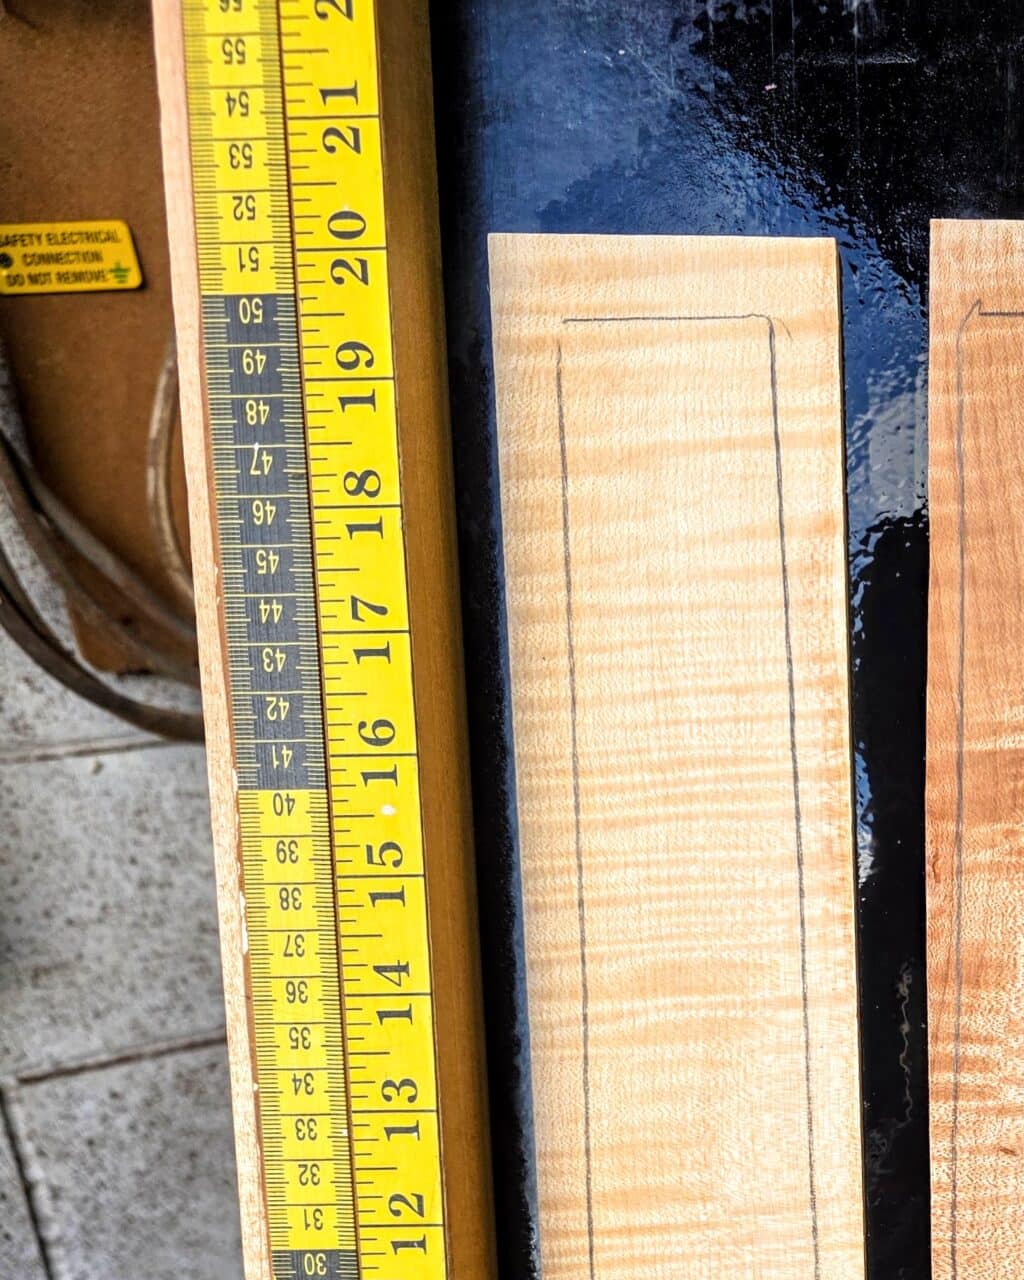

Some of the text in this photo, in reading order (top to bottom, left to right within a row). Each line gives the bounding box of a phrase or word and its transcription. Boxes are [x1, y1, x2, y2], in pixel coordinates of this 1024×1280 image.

[222, 39, 246, 64] 55
[225, 91, 249, 117] 54
[319, 80, 361, 154] 21
[229, 143, 253, 169] 53
[232, 195, 256, 220] 52
[238, 247, 260, 272] 51
[328, 210, 369, 287] 20
[239, 298, 263, 324] 50
[243, 350, 267, 374] 49
[336, 341, 376, 413] 19
[246, 400, 270, 425] 48
[250, 450, 273, 475] 47
[252, 501, 276, 525] 46
[343, 469, 384, 540] 18
[256, 550, 279, 574] 45
[259, 600, 283, 624] 44
[351, 595, 391, 664] 17
[262, 648, 286, 672] 43
[266, 697, 290, 721] 42
[271, 745, 293, 769] 41
[358, 719, 399, 787] 16
[273, 793, 295, 816] 40
[276, 840, 299, 863] 39
[366, 841, 406, 908] 15
[279, 887, 302, 911] 38
[283, 934, 305, 957] 37
[285, 981, 308, 1004] 36
[373, 960, 413, 1026] 14
[288, 1027, 312, 1050] 35
[292, 1073, 314, 1096] 34
[381, 1078, 420, 1141] 13
[295, 1118, 318, 1141] 33
[298, 1163, 320, 1186] 32
[303, 1208, 323, 1230] 31
[388, 1192, 427, 1255] 12
[303, 1253, 327, 1275] 30
